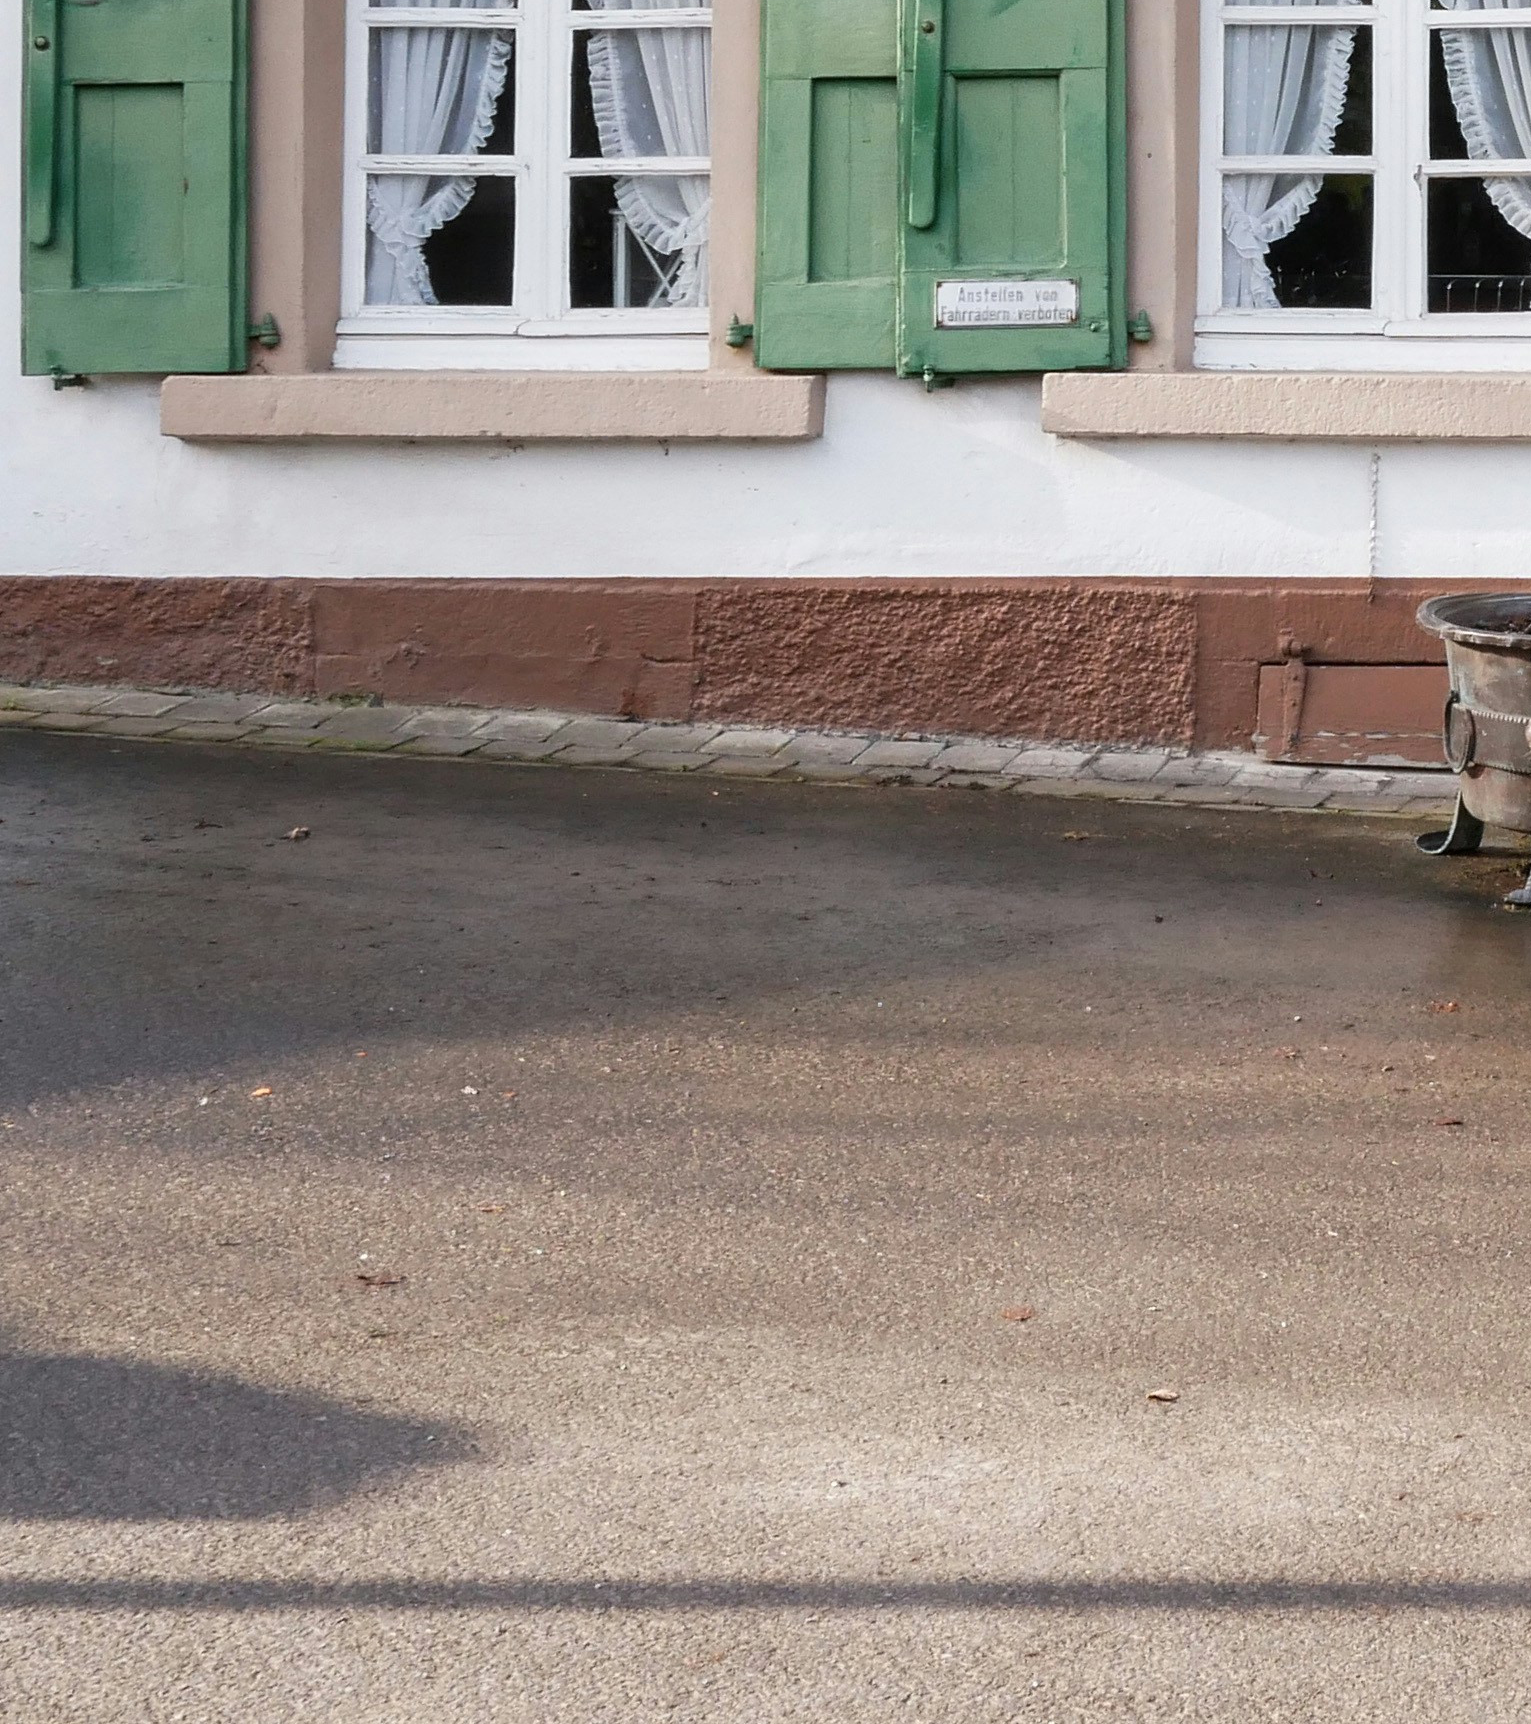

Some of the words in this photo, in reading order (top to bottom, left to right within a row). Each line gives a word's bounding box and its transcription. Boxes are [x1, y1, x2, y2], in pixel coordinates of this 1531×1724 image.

[958, 287, 1024, 303] Anstellen
[1035, 288, 1058, 302] von
[1018, 304, 1074, 322] verboten
